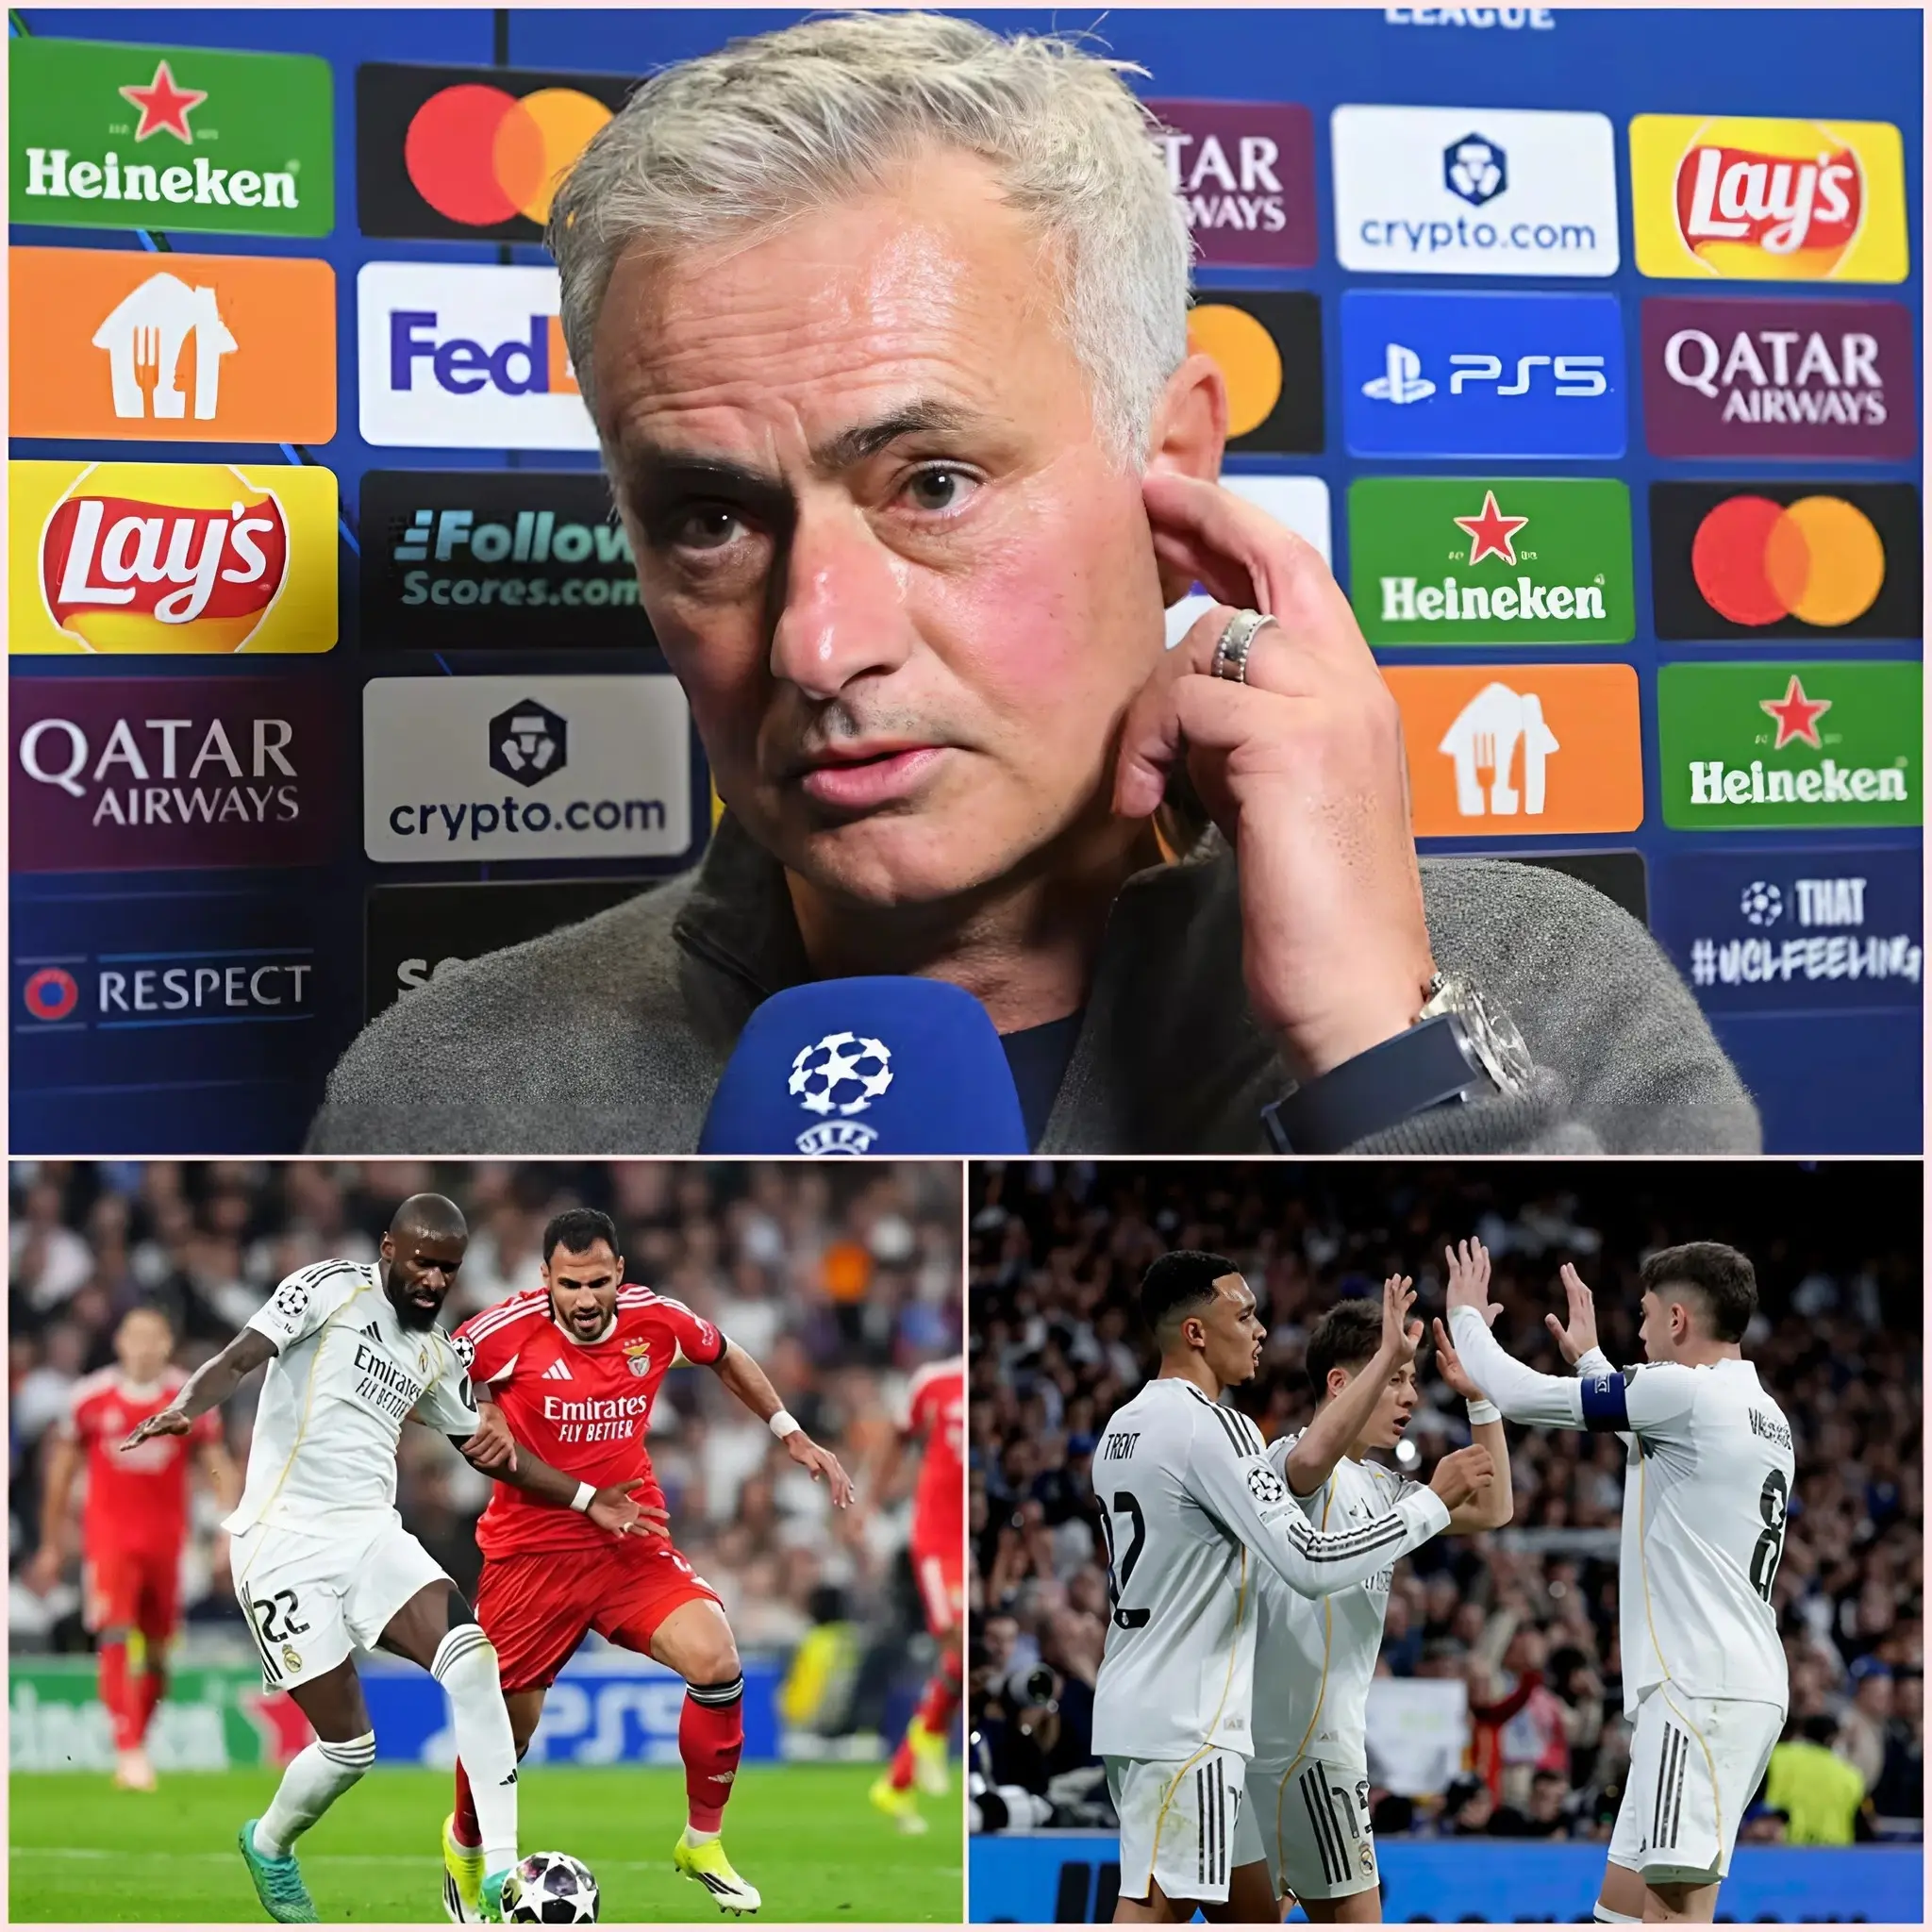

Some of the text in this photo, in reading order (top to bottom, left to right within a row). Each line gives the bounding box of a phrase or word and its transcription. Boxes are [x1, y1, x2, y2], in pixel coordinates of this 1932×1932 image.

[25, 148, 299, 208] Heineken
[1688, 148, 1854, 256] Lay's
[1360, 217, 1596, 252] crypto.com
[1450, 355, 1607, 397] PS5
[1664, 329, 1883, 398] QATAR
[1722, 389, 1887, 425] AIRWAYS
[58, 500, 274, 623] Lay's
[1380, 576, 1607, 621] Heineken
[19, 718, 298, 796] QATAR
[1690, 758, 1907, 804] Heineken
[92, 786, 299, 825] AIRWAYS
[389, 796, 667, 840] crypto.com
[1795, 877, 1867, 926] THAT
[99, 965, 311, 1012] RESPECT
[544, 1394, 647, 1421] Emirates
[558, 1420, 633, 1442] FLY BETTER
[1749, 1468, 1788, 1605] 8
[253, 1589, 310, 1642] 22
